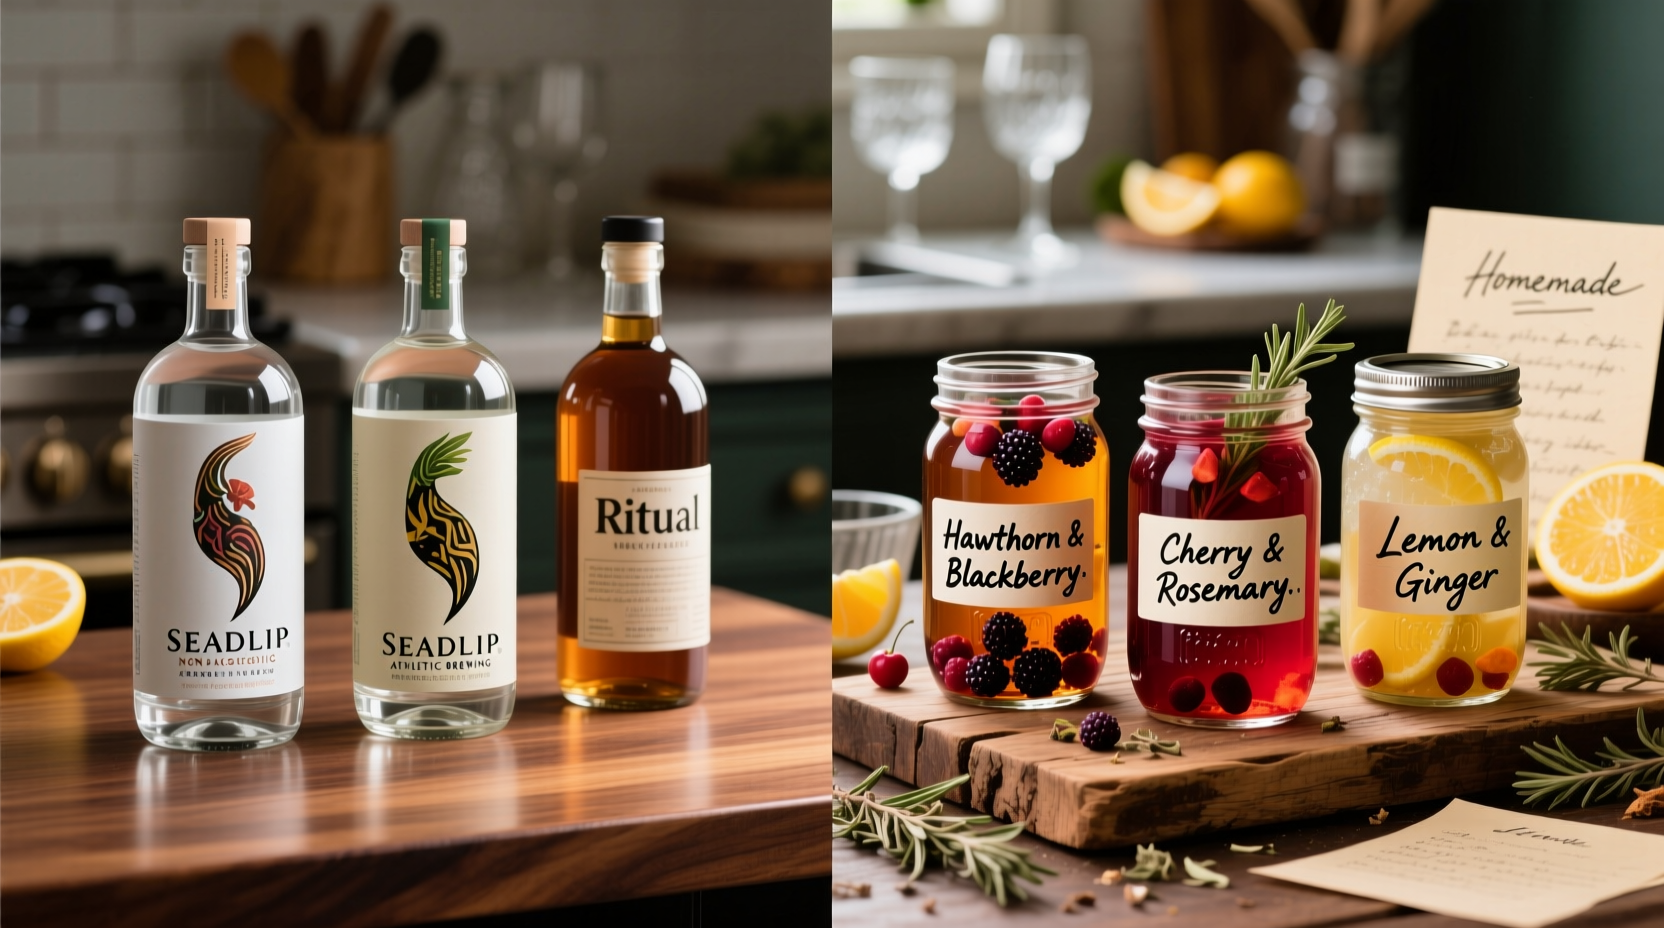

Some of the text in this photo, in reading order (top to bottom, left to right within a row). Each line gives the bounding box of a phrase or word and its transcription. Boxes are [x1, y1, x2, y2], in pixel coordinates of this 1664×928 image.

[1464, 250, 1644, 297] Homemade
[595, 494, 699, 535] Ritual
[943, 518, 1084, 551] Hawthorn &
[1160, 532, 1284, 580] Cherry &
[1376, 515, 1511, 559] Lemon &
[1395, 562, 1499, 611] Ginger
[167, 626, 289, 653] SEADLIP
[382, 632, 499, 658] SEADLIP
